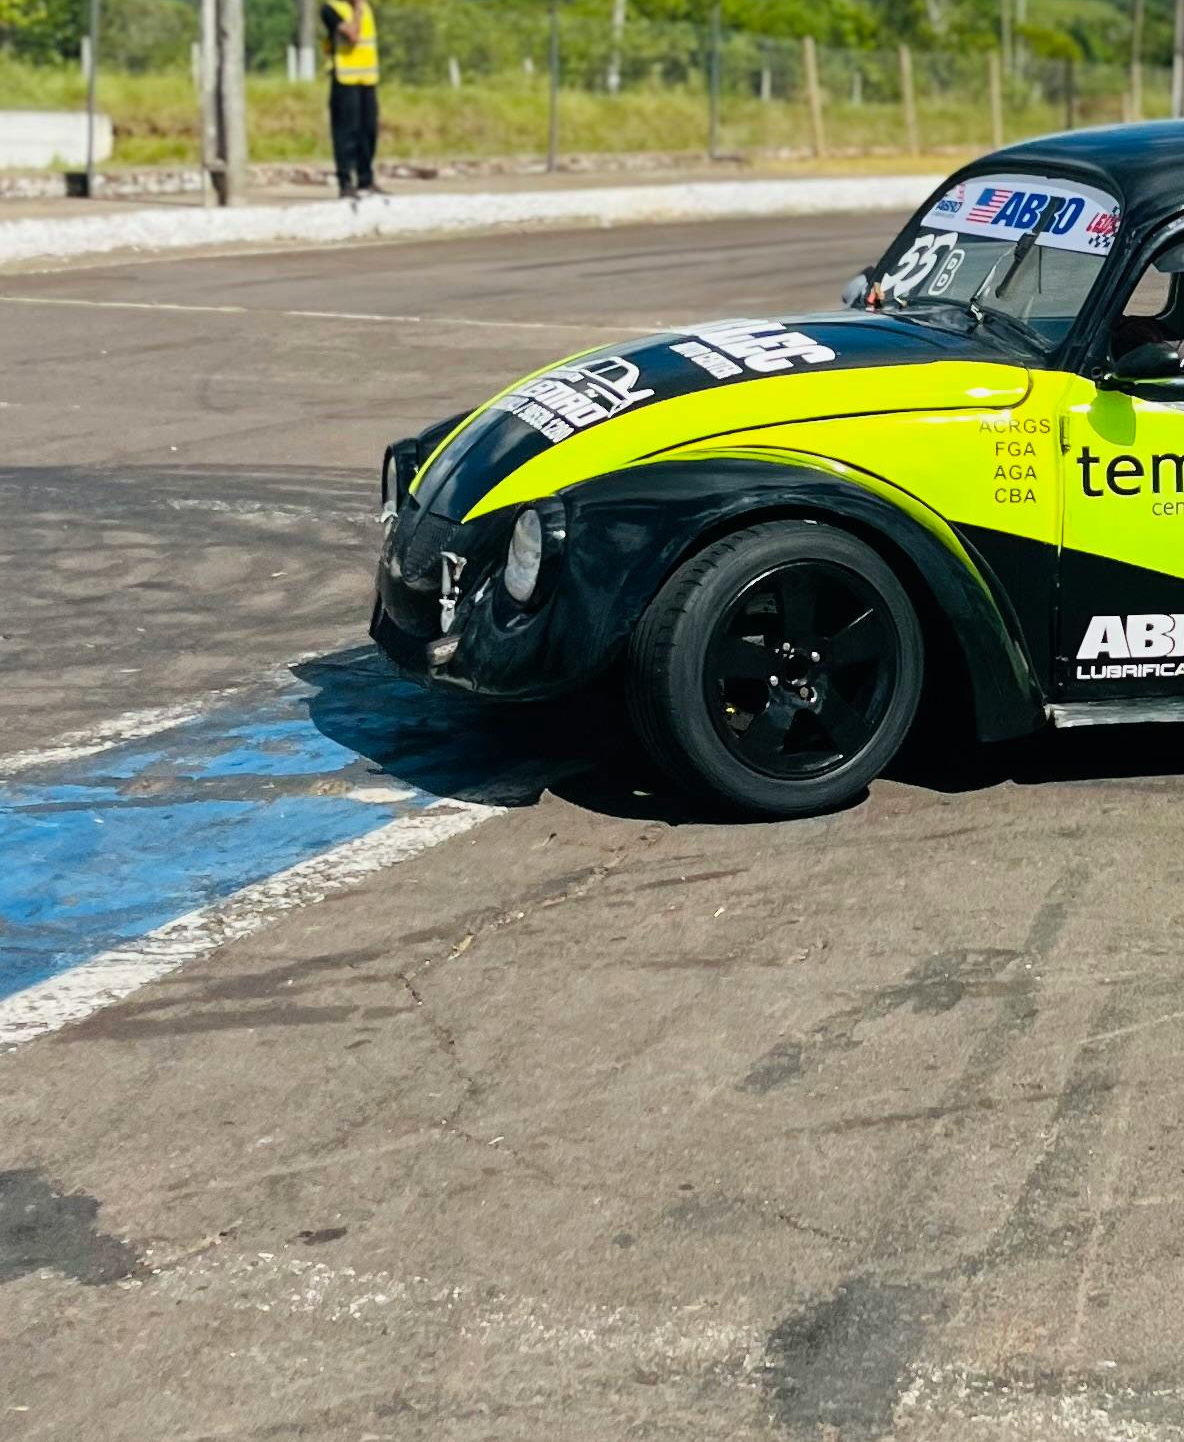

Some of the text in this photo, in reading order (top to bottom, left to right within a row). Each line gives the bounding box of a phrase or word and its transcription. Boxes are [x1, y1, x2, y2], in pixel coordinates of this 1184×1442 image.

[880, 232, 958, 299] 55
[979, 419, 1050, 433] ACRGS
[995, 441, 1036, 456] FGA
[993, 465, 1037, 480] AGA
[994, 488, 1037, 503] CBA
